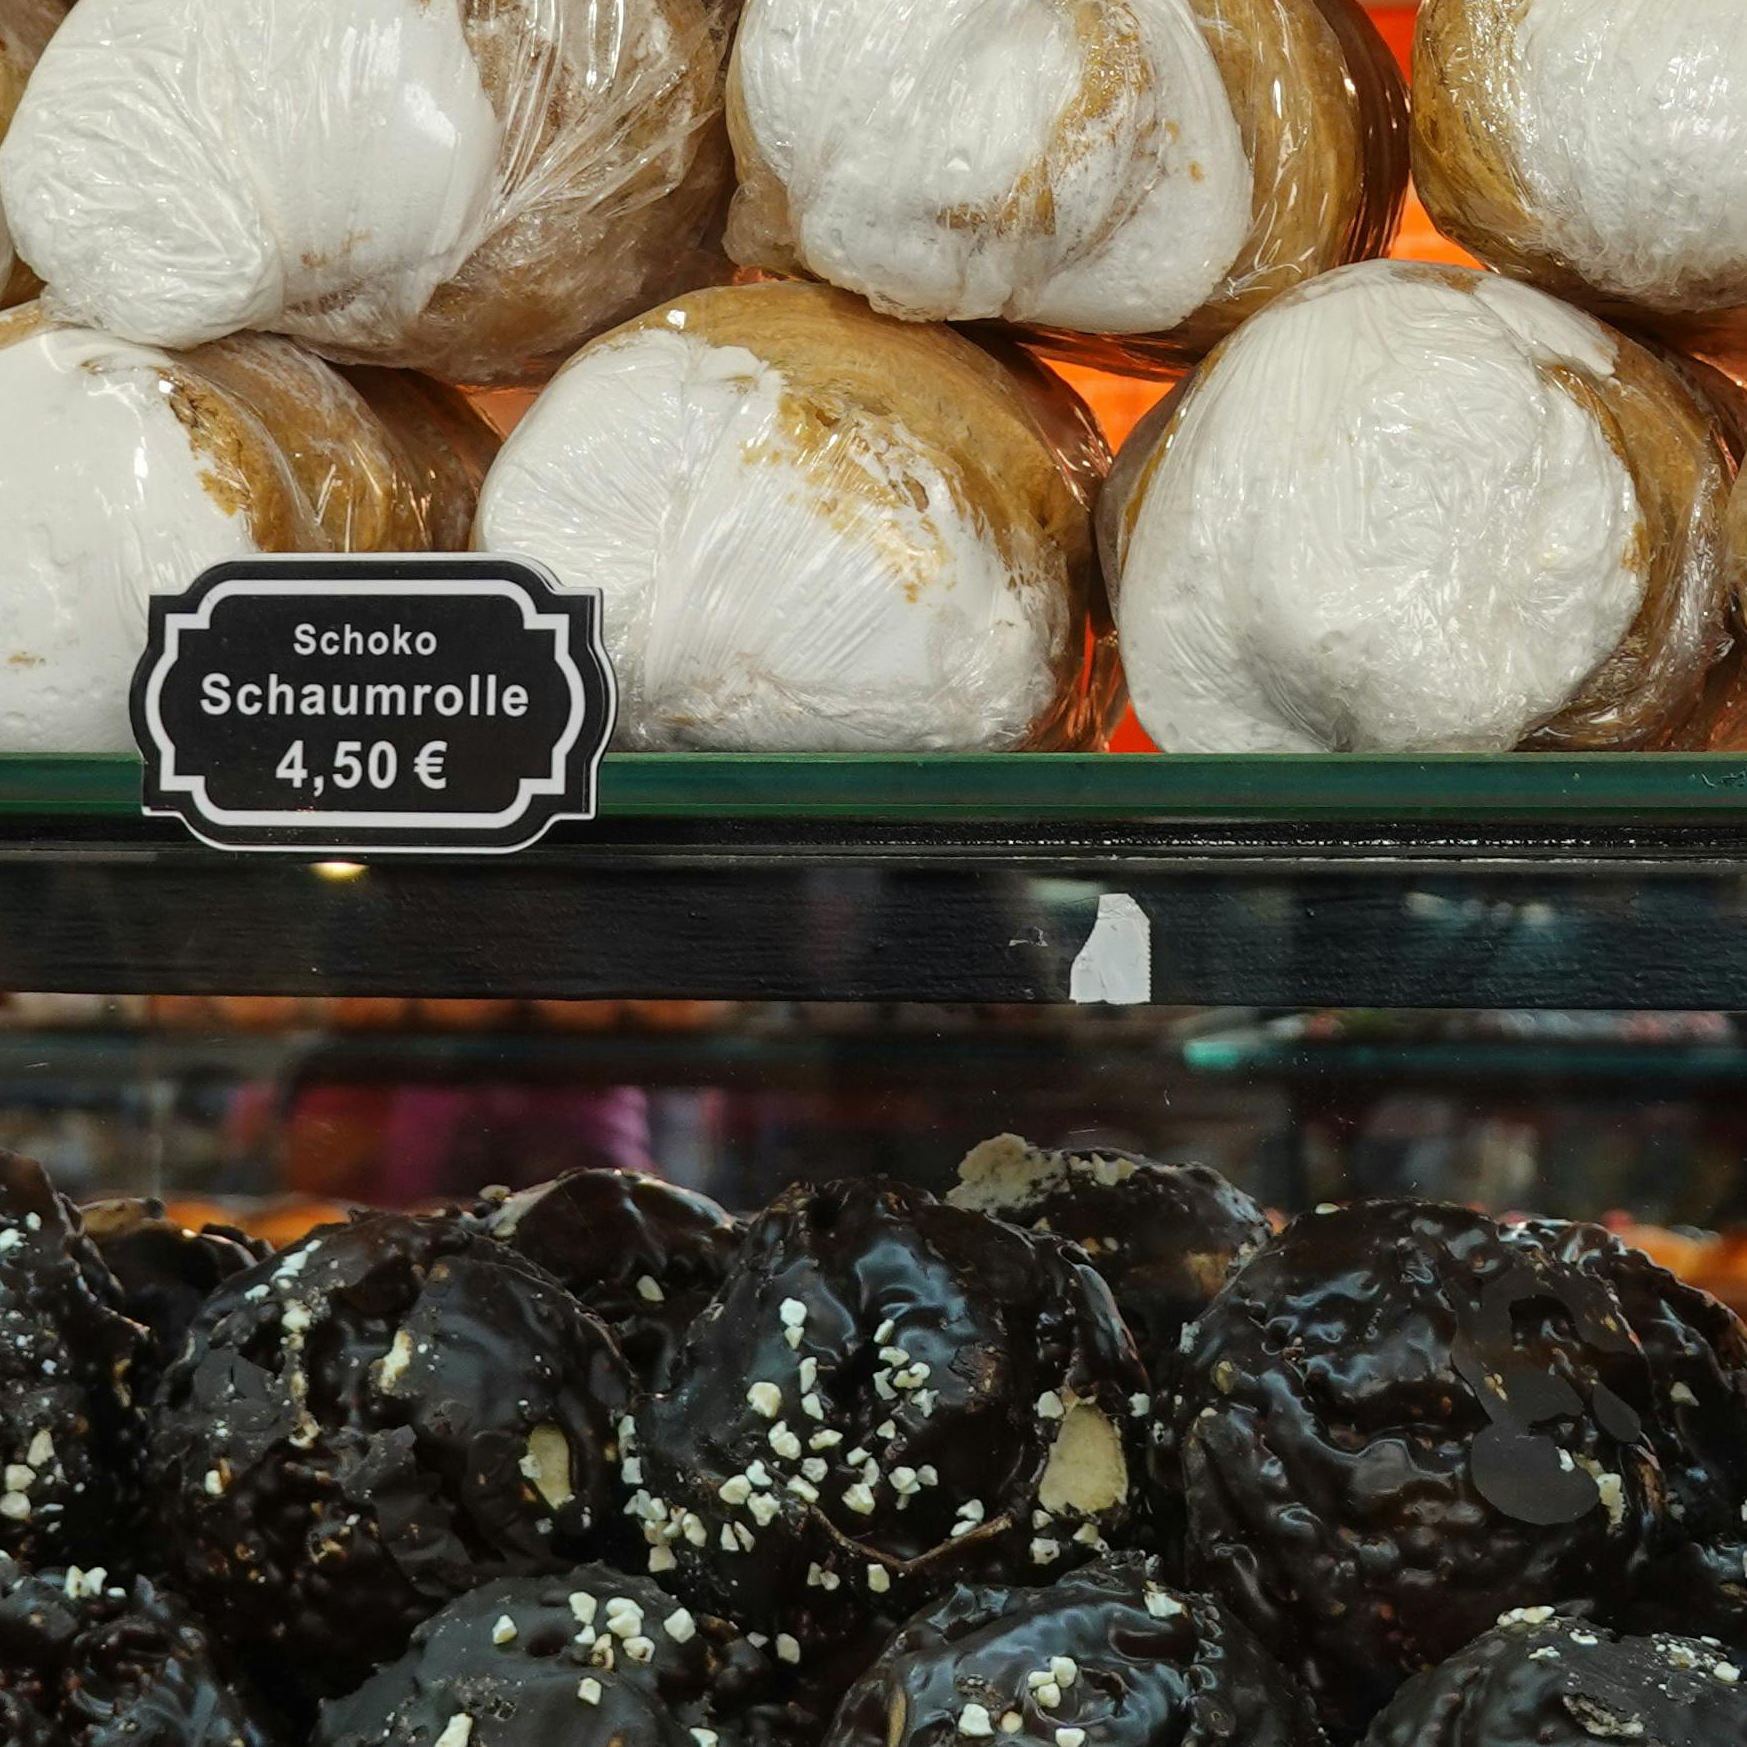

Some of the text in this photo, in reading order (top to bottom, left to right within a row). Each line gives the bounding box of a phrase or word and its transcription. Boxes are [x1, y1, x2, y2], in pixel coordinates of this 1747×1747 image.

[294, 624, 436, 655] Schoko
[201, 673, 528, 716] Schaumrolle
[276, 740, 447, 796] 4,50 €
